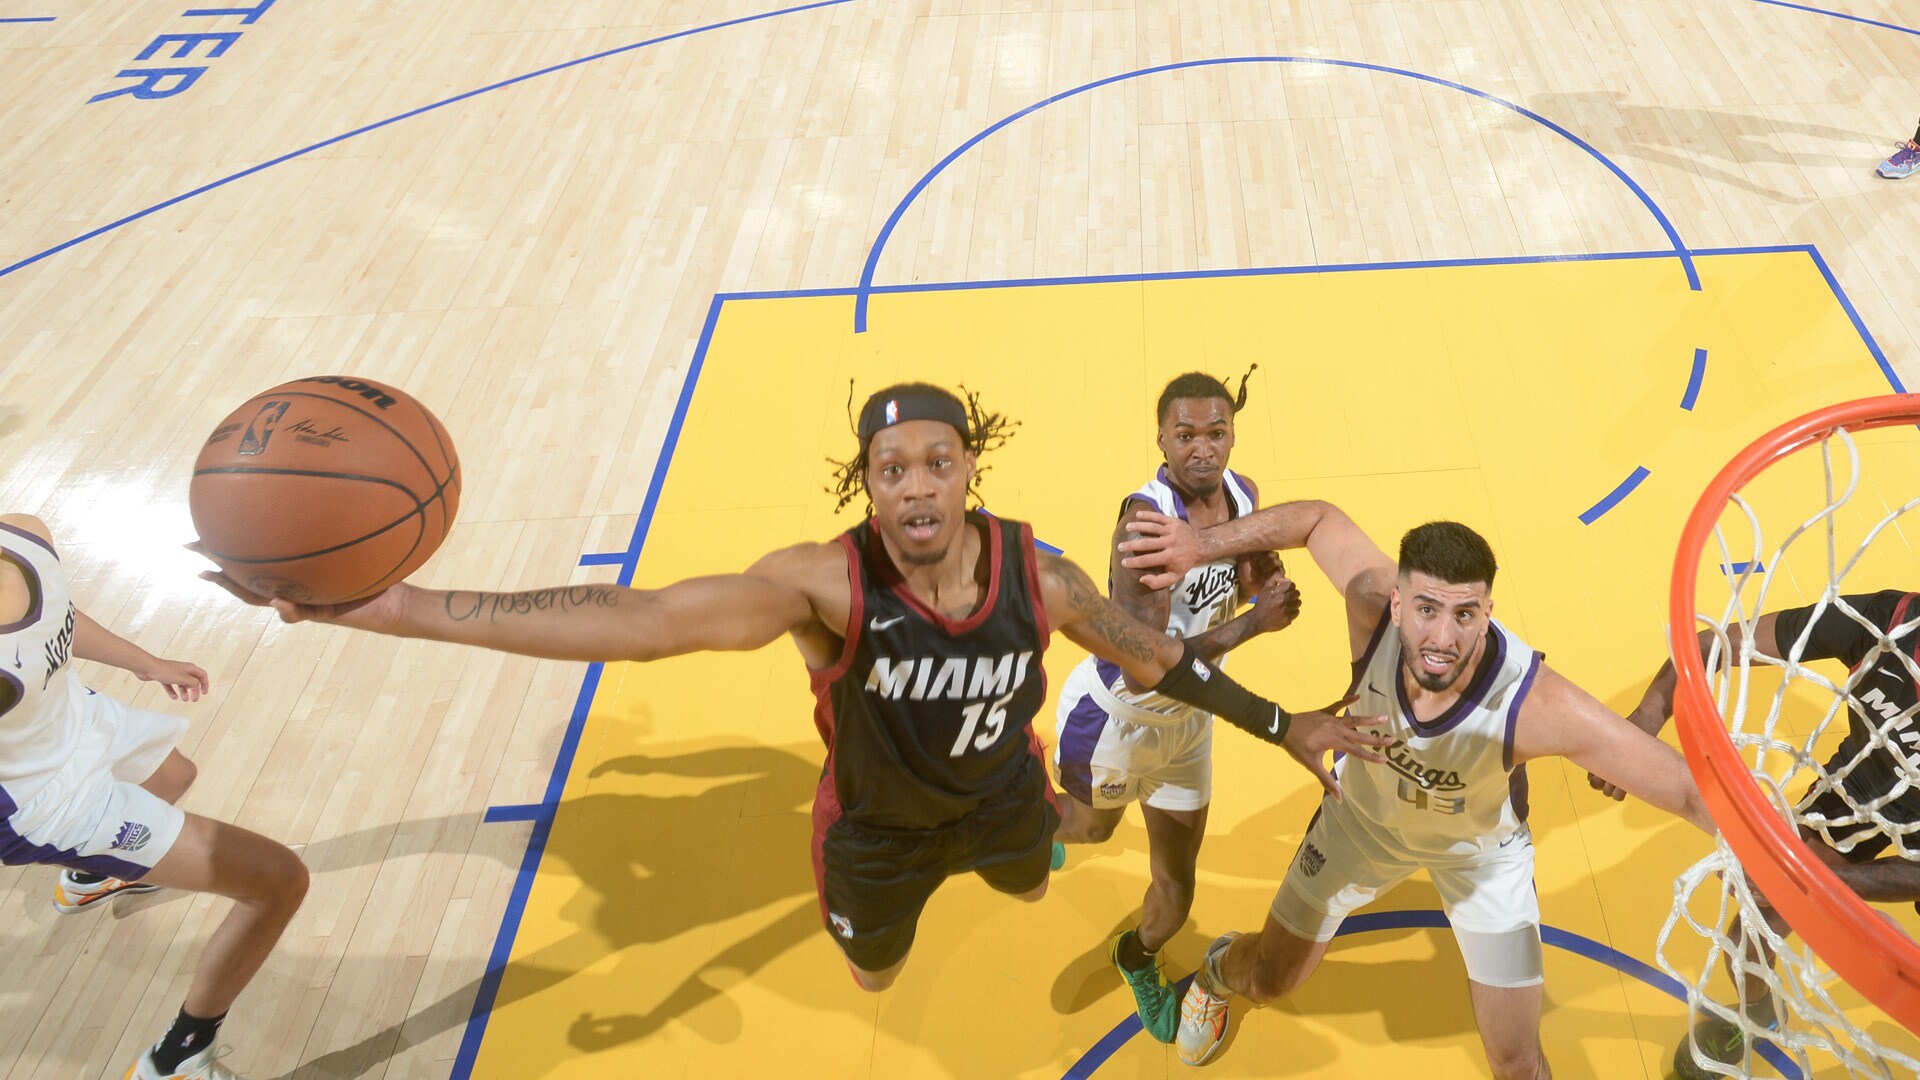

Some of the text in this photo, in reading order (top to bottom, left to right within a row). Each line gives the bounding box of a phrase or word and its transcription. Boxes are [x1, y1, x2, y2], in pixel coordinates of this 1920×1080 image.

[84, 0, 278, 104] TER
[1186, 565, 1238, 615] King
[865, 650, 1034, 702] MIAMI
[950, 691, 1015, 758] 15
[120, 822, 143, 851] KINGS
